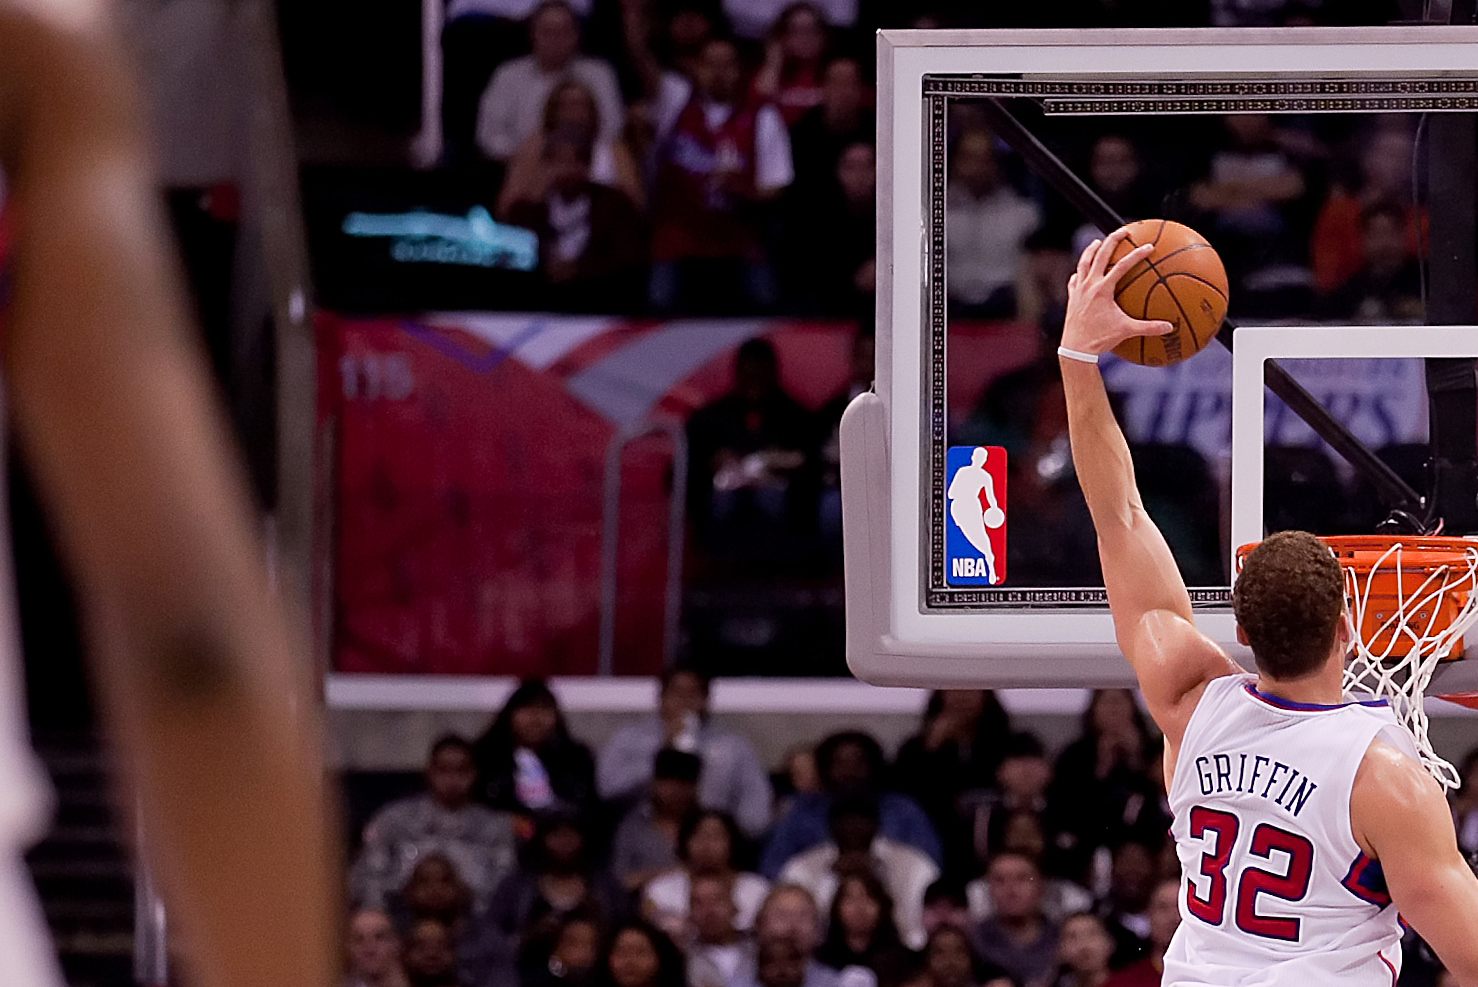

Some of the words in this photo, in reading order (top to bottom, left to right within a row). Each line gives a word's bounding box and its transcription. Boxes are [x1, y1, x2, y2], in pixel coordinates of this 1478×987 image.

[952, 557, 987, 578] NBA
[1195, 753, 1318, 818] GRIFFIN
[1186, 804, 1316, 943] 32
